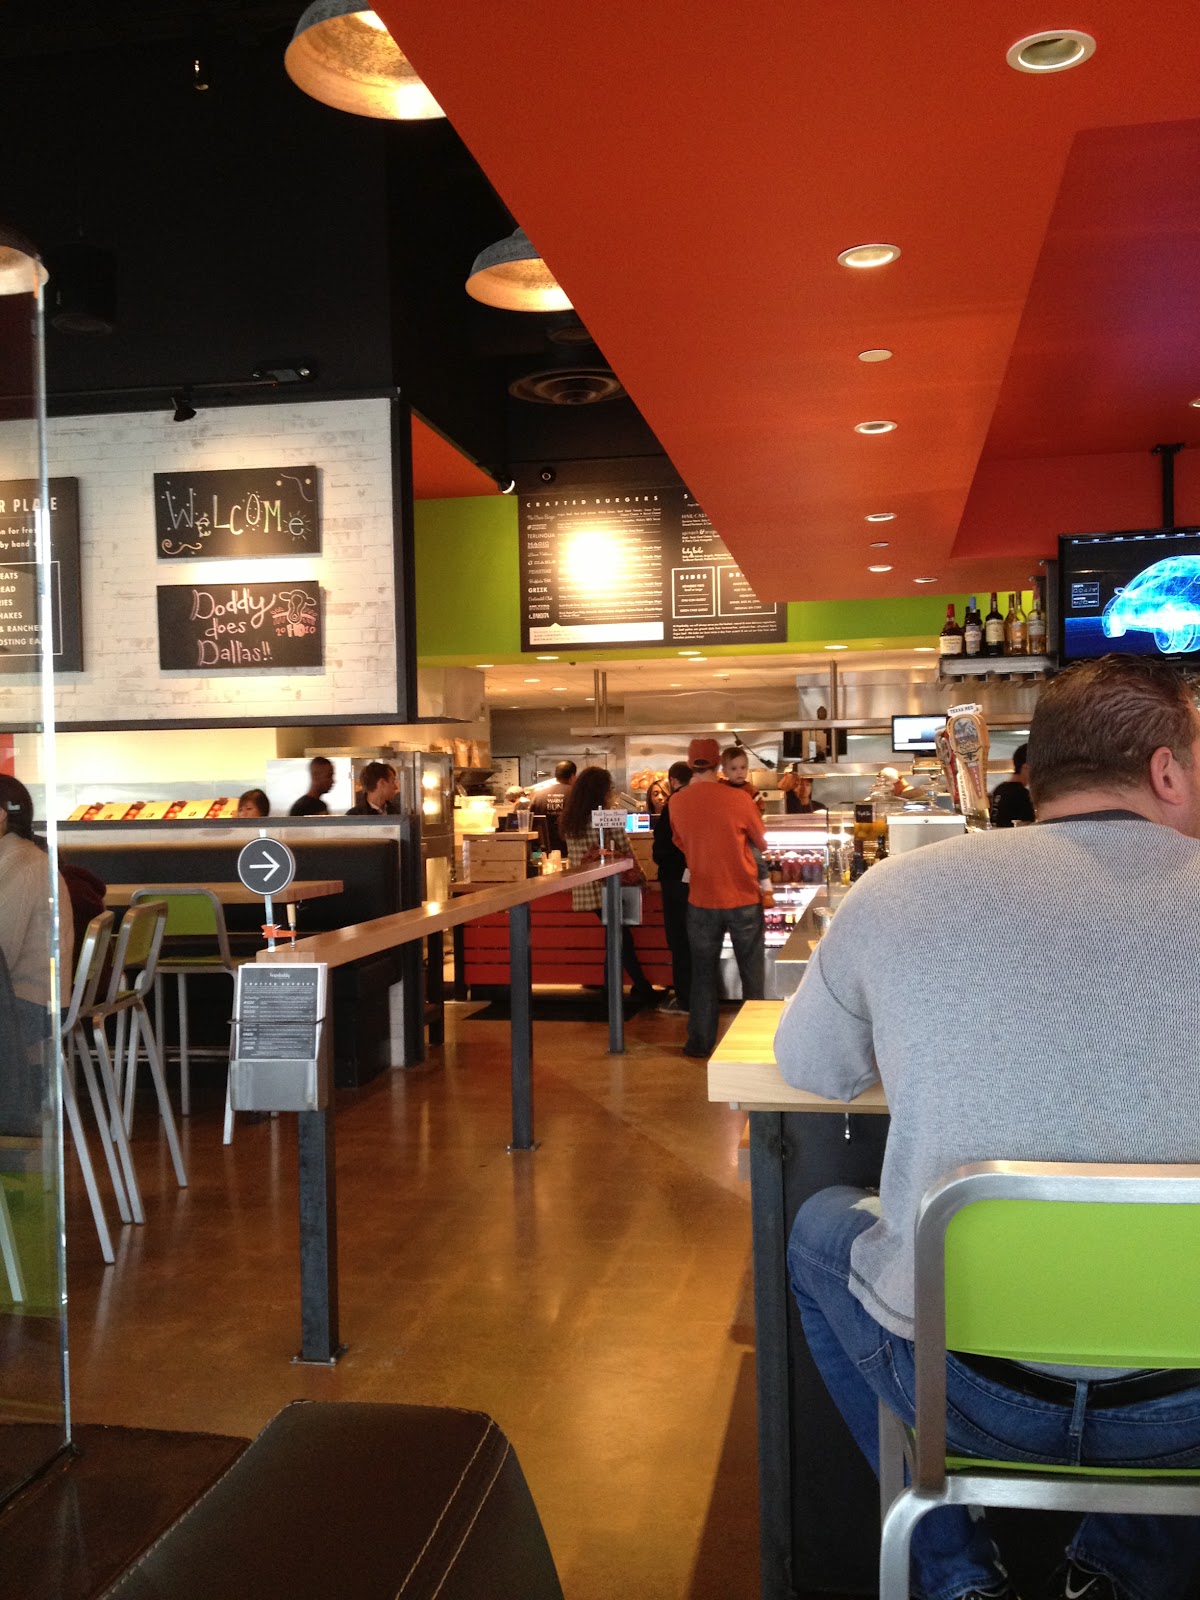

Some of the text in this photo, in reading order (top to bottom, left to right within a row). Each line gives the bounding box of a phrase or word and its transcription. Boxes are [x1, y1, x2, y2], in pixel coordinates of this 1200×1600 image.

[13, 496, 57, 512] PLAE
[526, 495, 658, 508] CRAFTED BURGERS
[11, 540, 30, 548] hand
[189, 588, 276, 629] Doddy
[205, 618, 247, 640] does
[196, 639, 273, 666] Dallas!!
